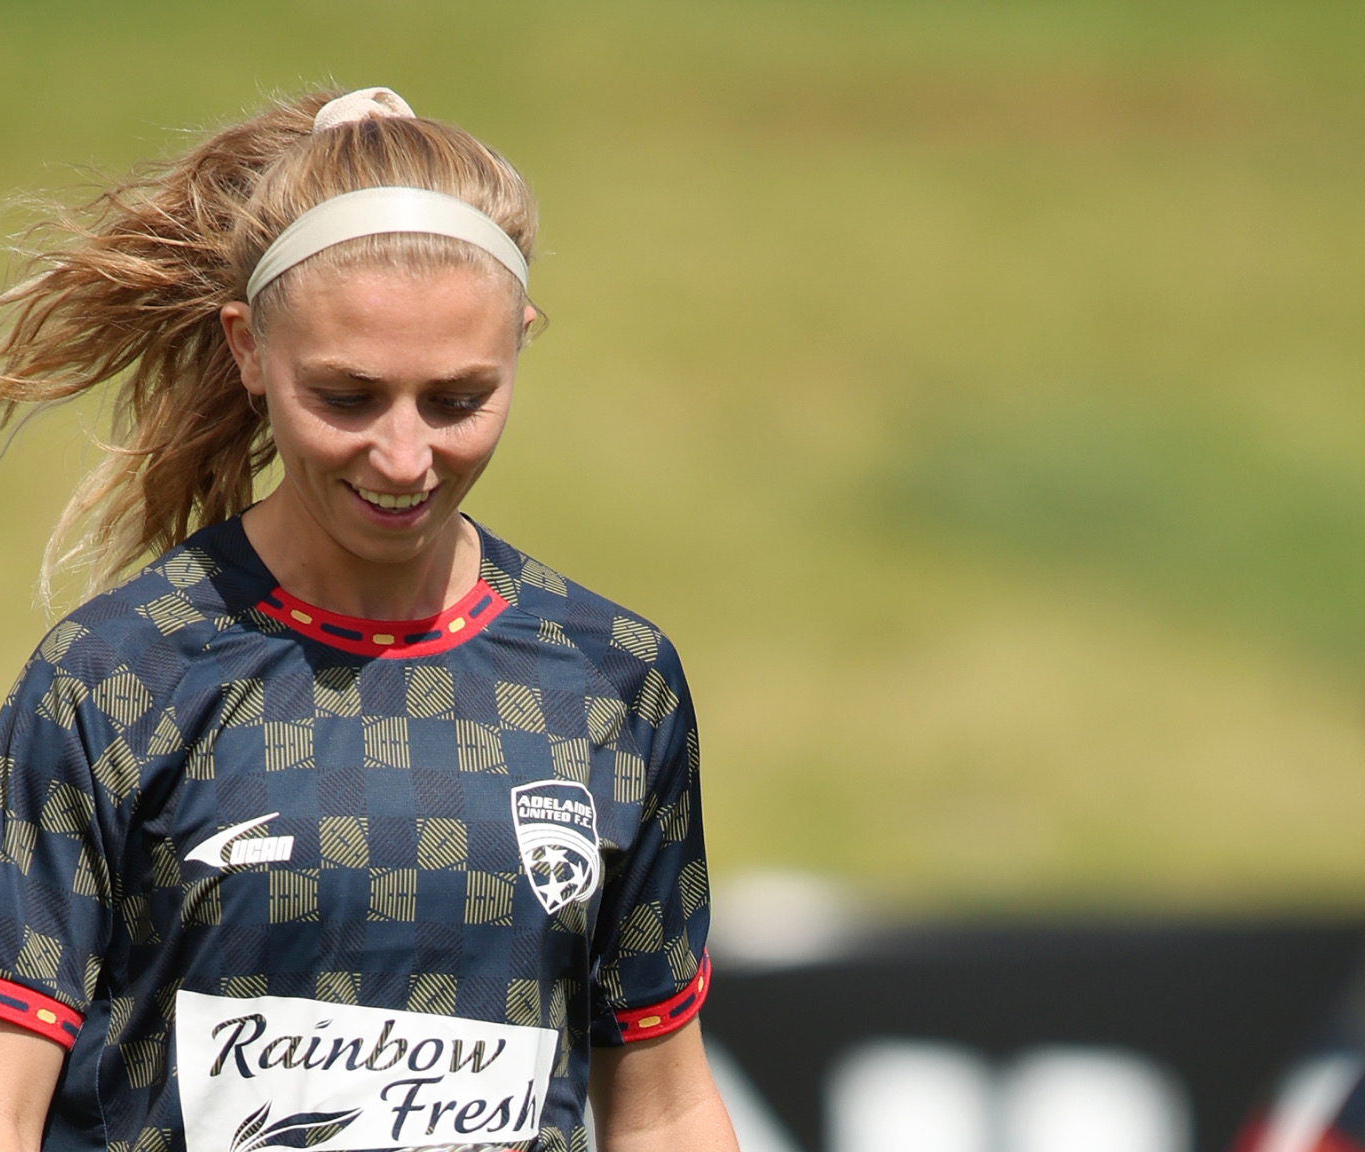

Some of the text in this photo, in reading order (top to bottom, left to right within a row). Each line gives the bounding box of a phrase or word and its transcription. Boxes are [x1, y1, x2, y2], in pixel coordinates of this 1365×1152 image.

[517, 794, 593, 819] ADELAIDE
[519, 806, 592, 829] UNITED F.C.
[209, 1012, 507, 1079] Rainbow
[379, 1074, 537, 1142] Fresh
